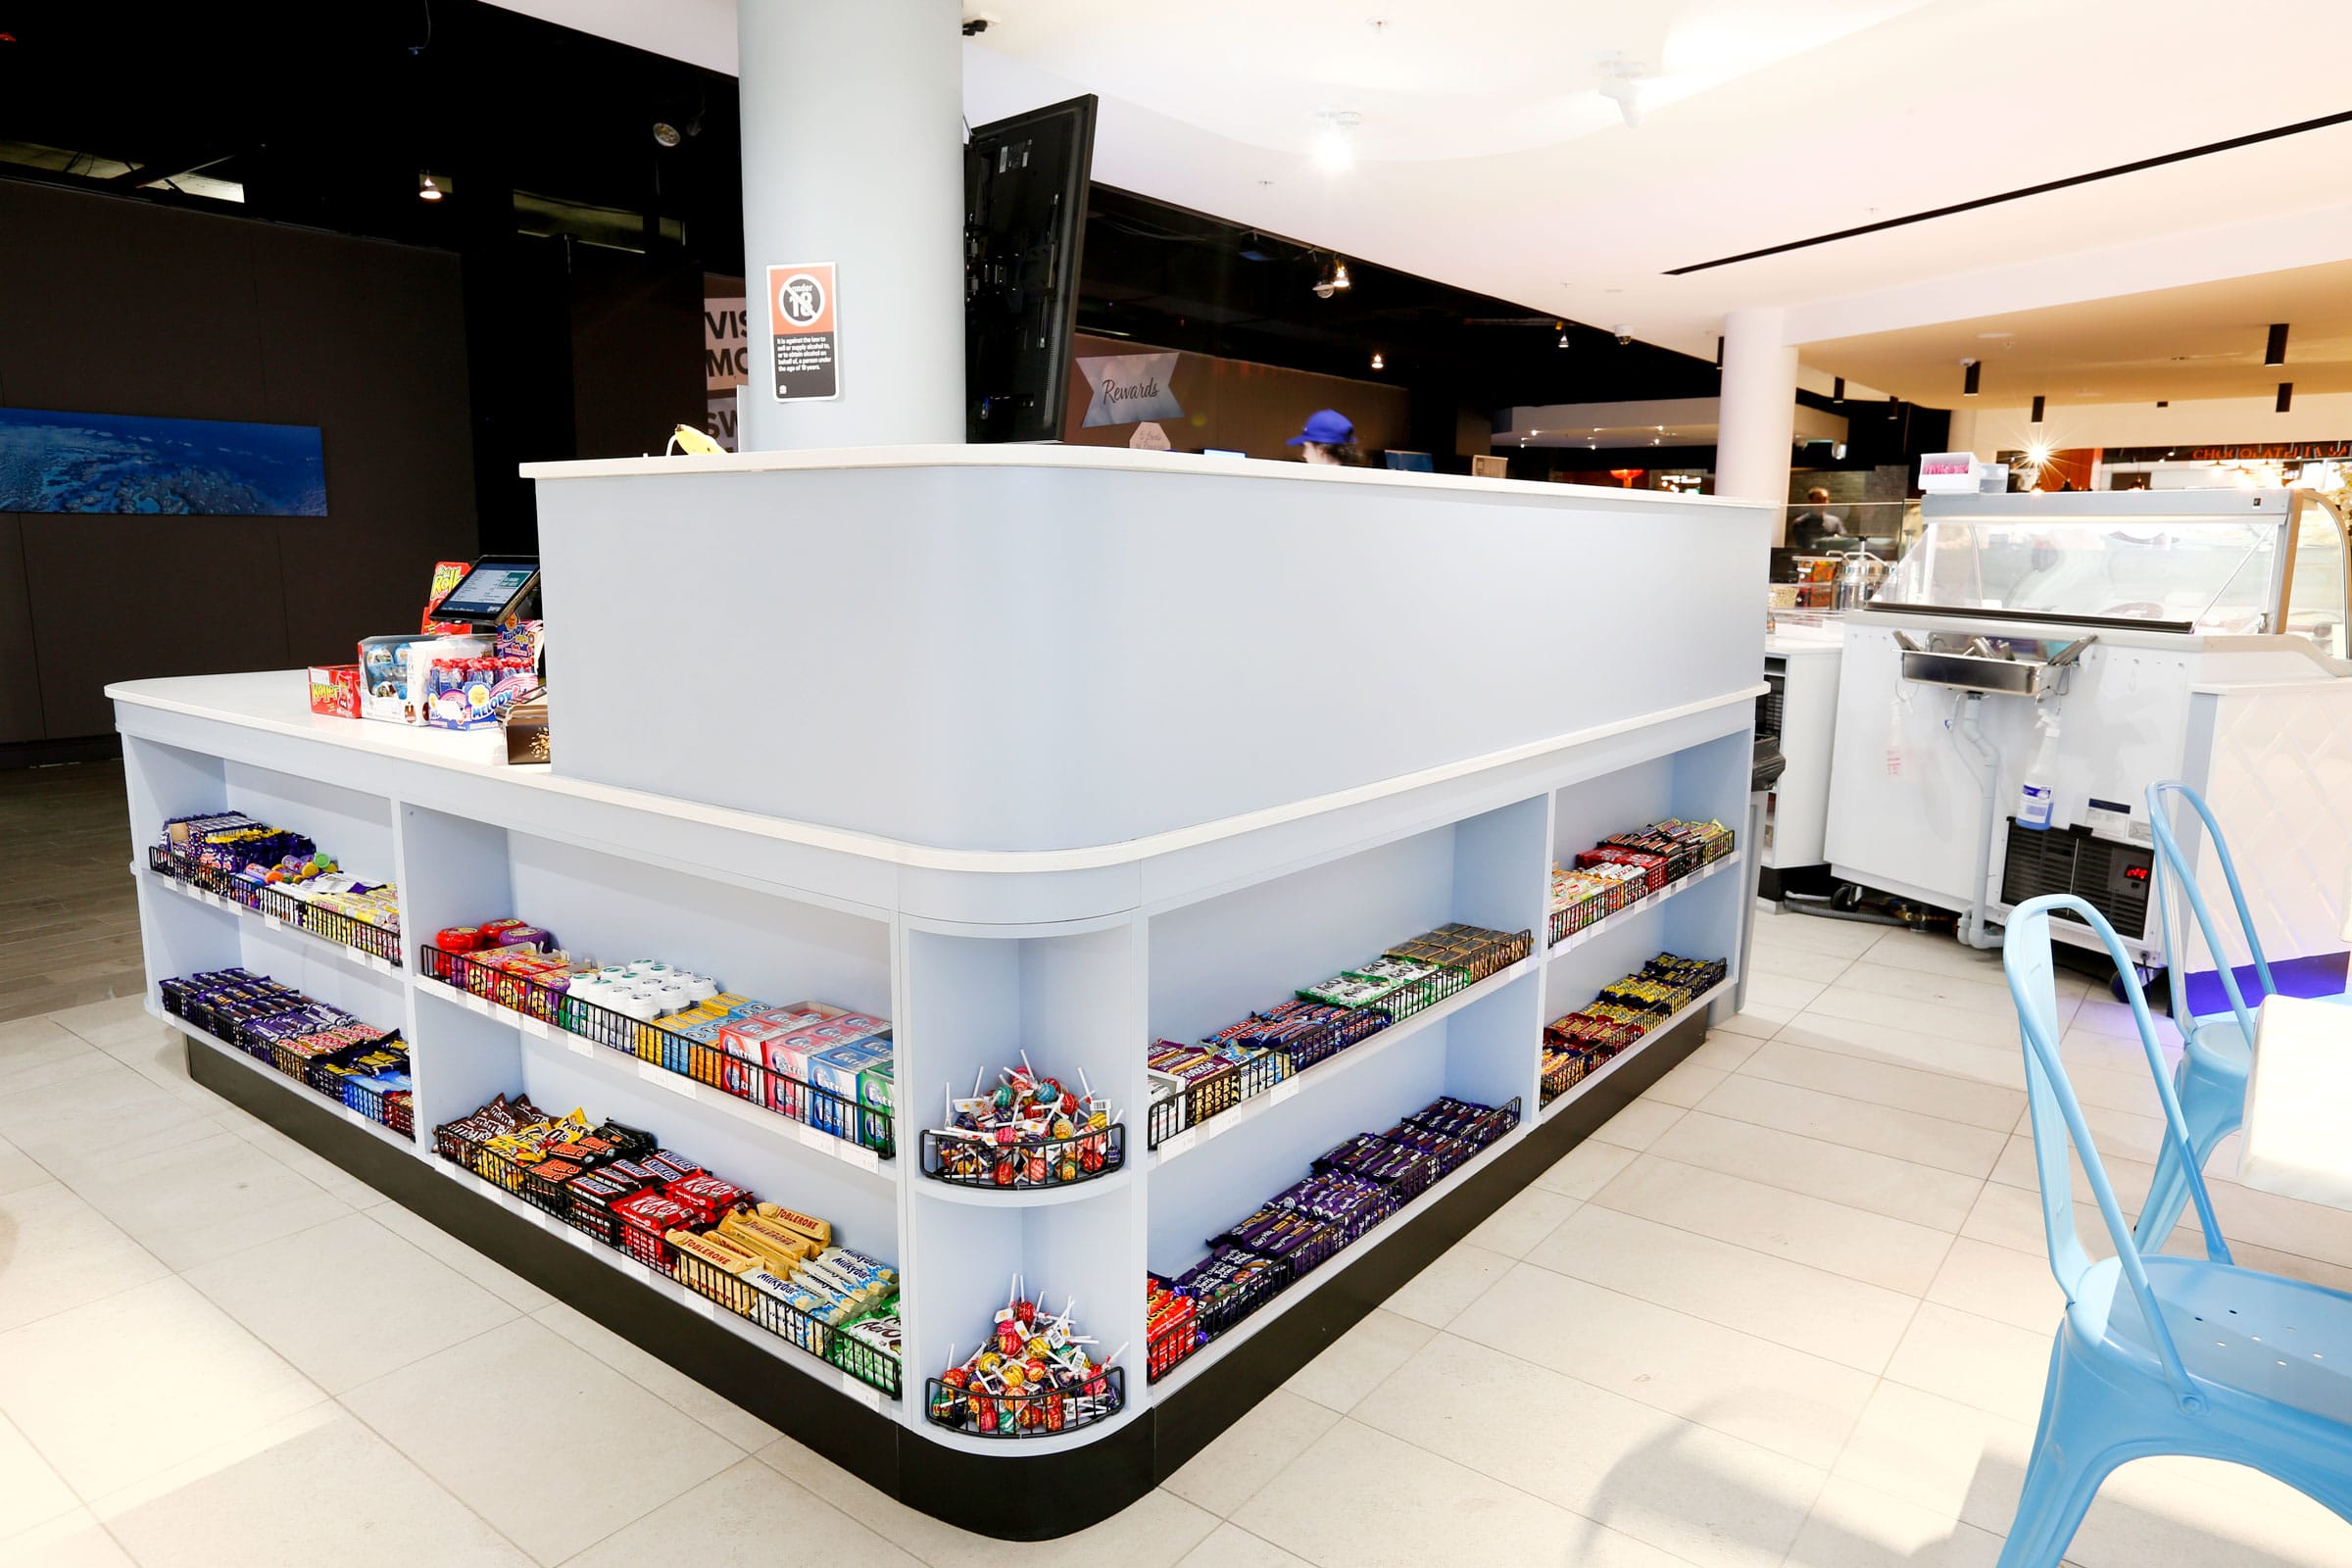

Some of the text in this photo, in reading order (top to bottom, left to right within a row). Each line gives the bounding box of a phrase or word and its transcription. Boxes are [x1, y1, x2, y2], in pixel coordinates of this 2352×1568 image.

[789, 292, 813, 318] 18
[1102, 377, 1159, 405] Rewards
[777, 1207, 819, 1230] TOBLERONE
[684, 1239, 731, 1265] TOBLERONE
[832, 1257, 871, 1279] Milkybar
[757, 1273, 799, 1294] Milkybar
